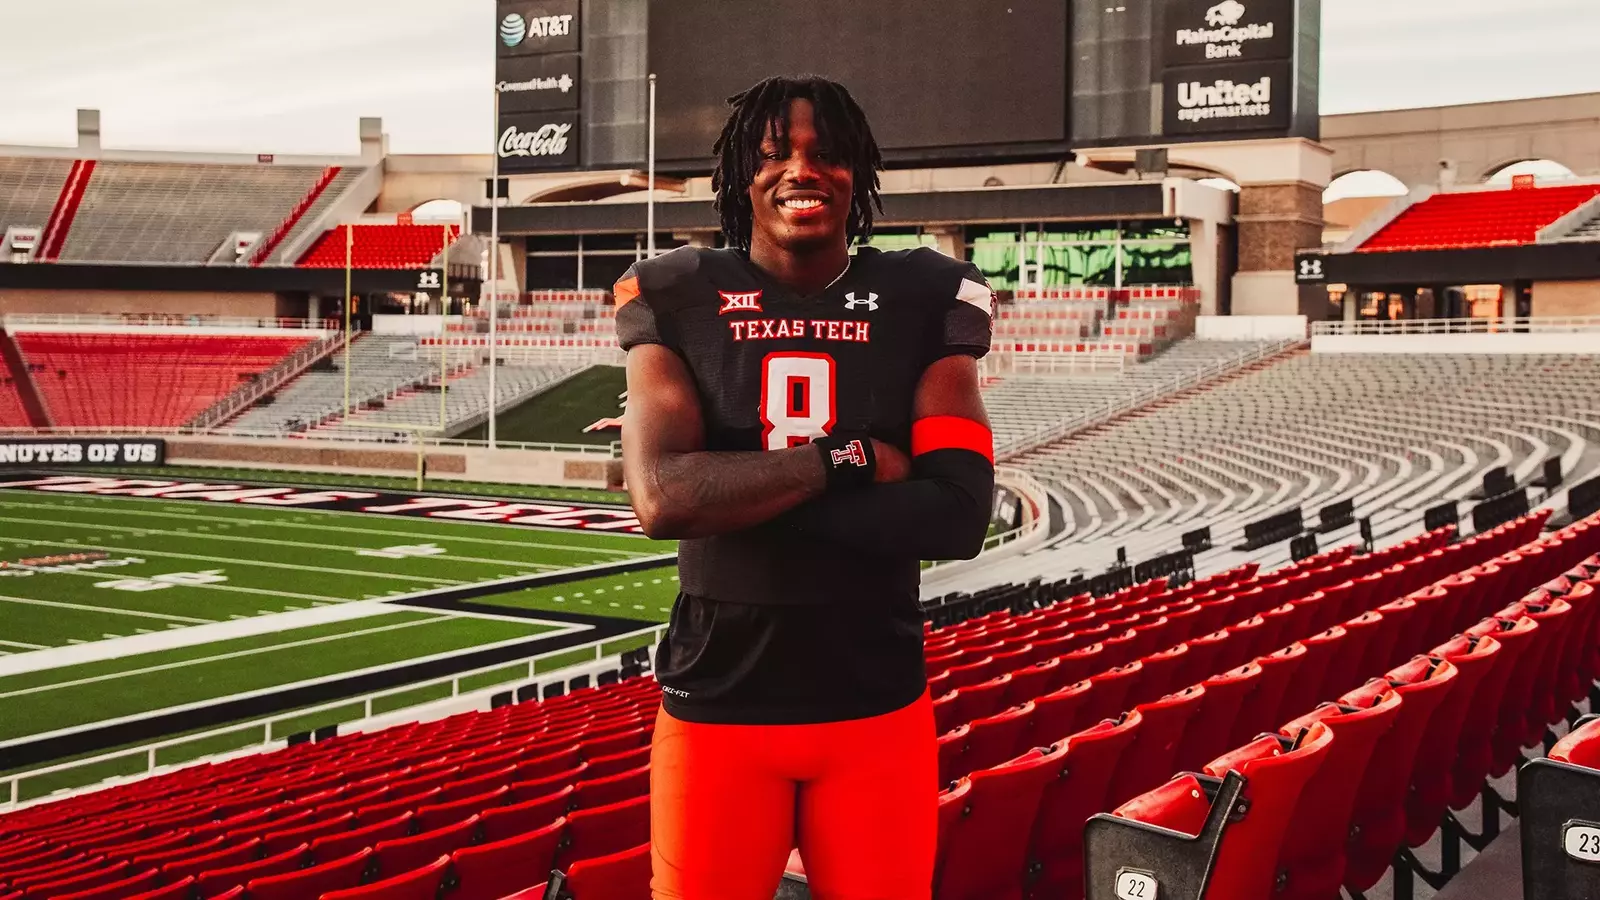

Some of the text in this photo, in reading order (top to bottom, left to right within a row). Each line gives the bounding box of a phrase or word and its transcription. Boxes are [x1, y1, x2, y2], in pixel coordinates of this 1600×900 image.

[528, 15, 572, 38] AT&T
[1176, 22, 1274, 45] PlainsCapital
[1205, 42, 1242, 59] Bank
[1177, 76, 1271, 108] United
[1177, 103, 1270, 122] supermarkets
[729, 319, 870, 342] TEXAS TECH
[760, 351, 837, 451] 8
[87, 443, 119, 462] OF
[123, 443, 157, 462] US
[362, 497, 644, 532] TEC
[1579, 833, 1600, 854] 23
[1128, 879, 1145, 898] 22
